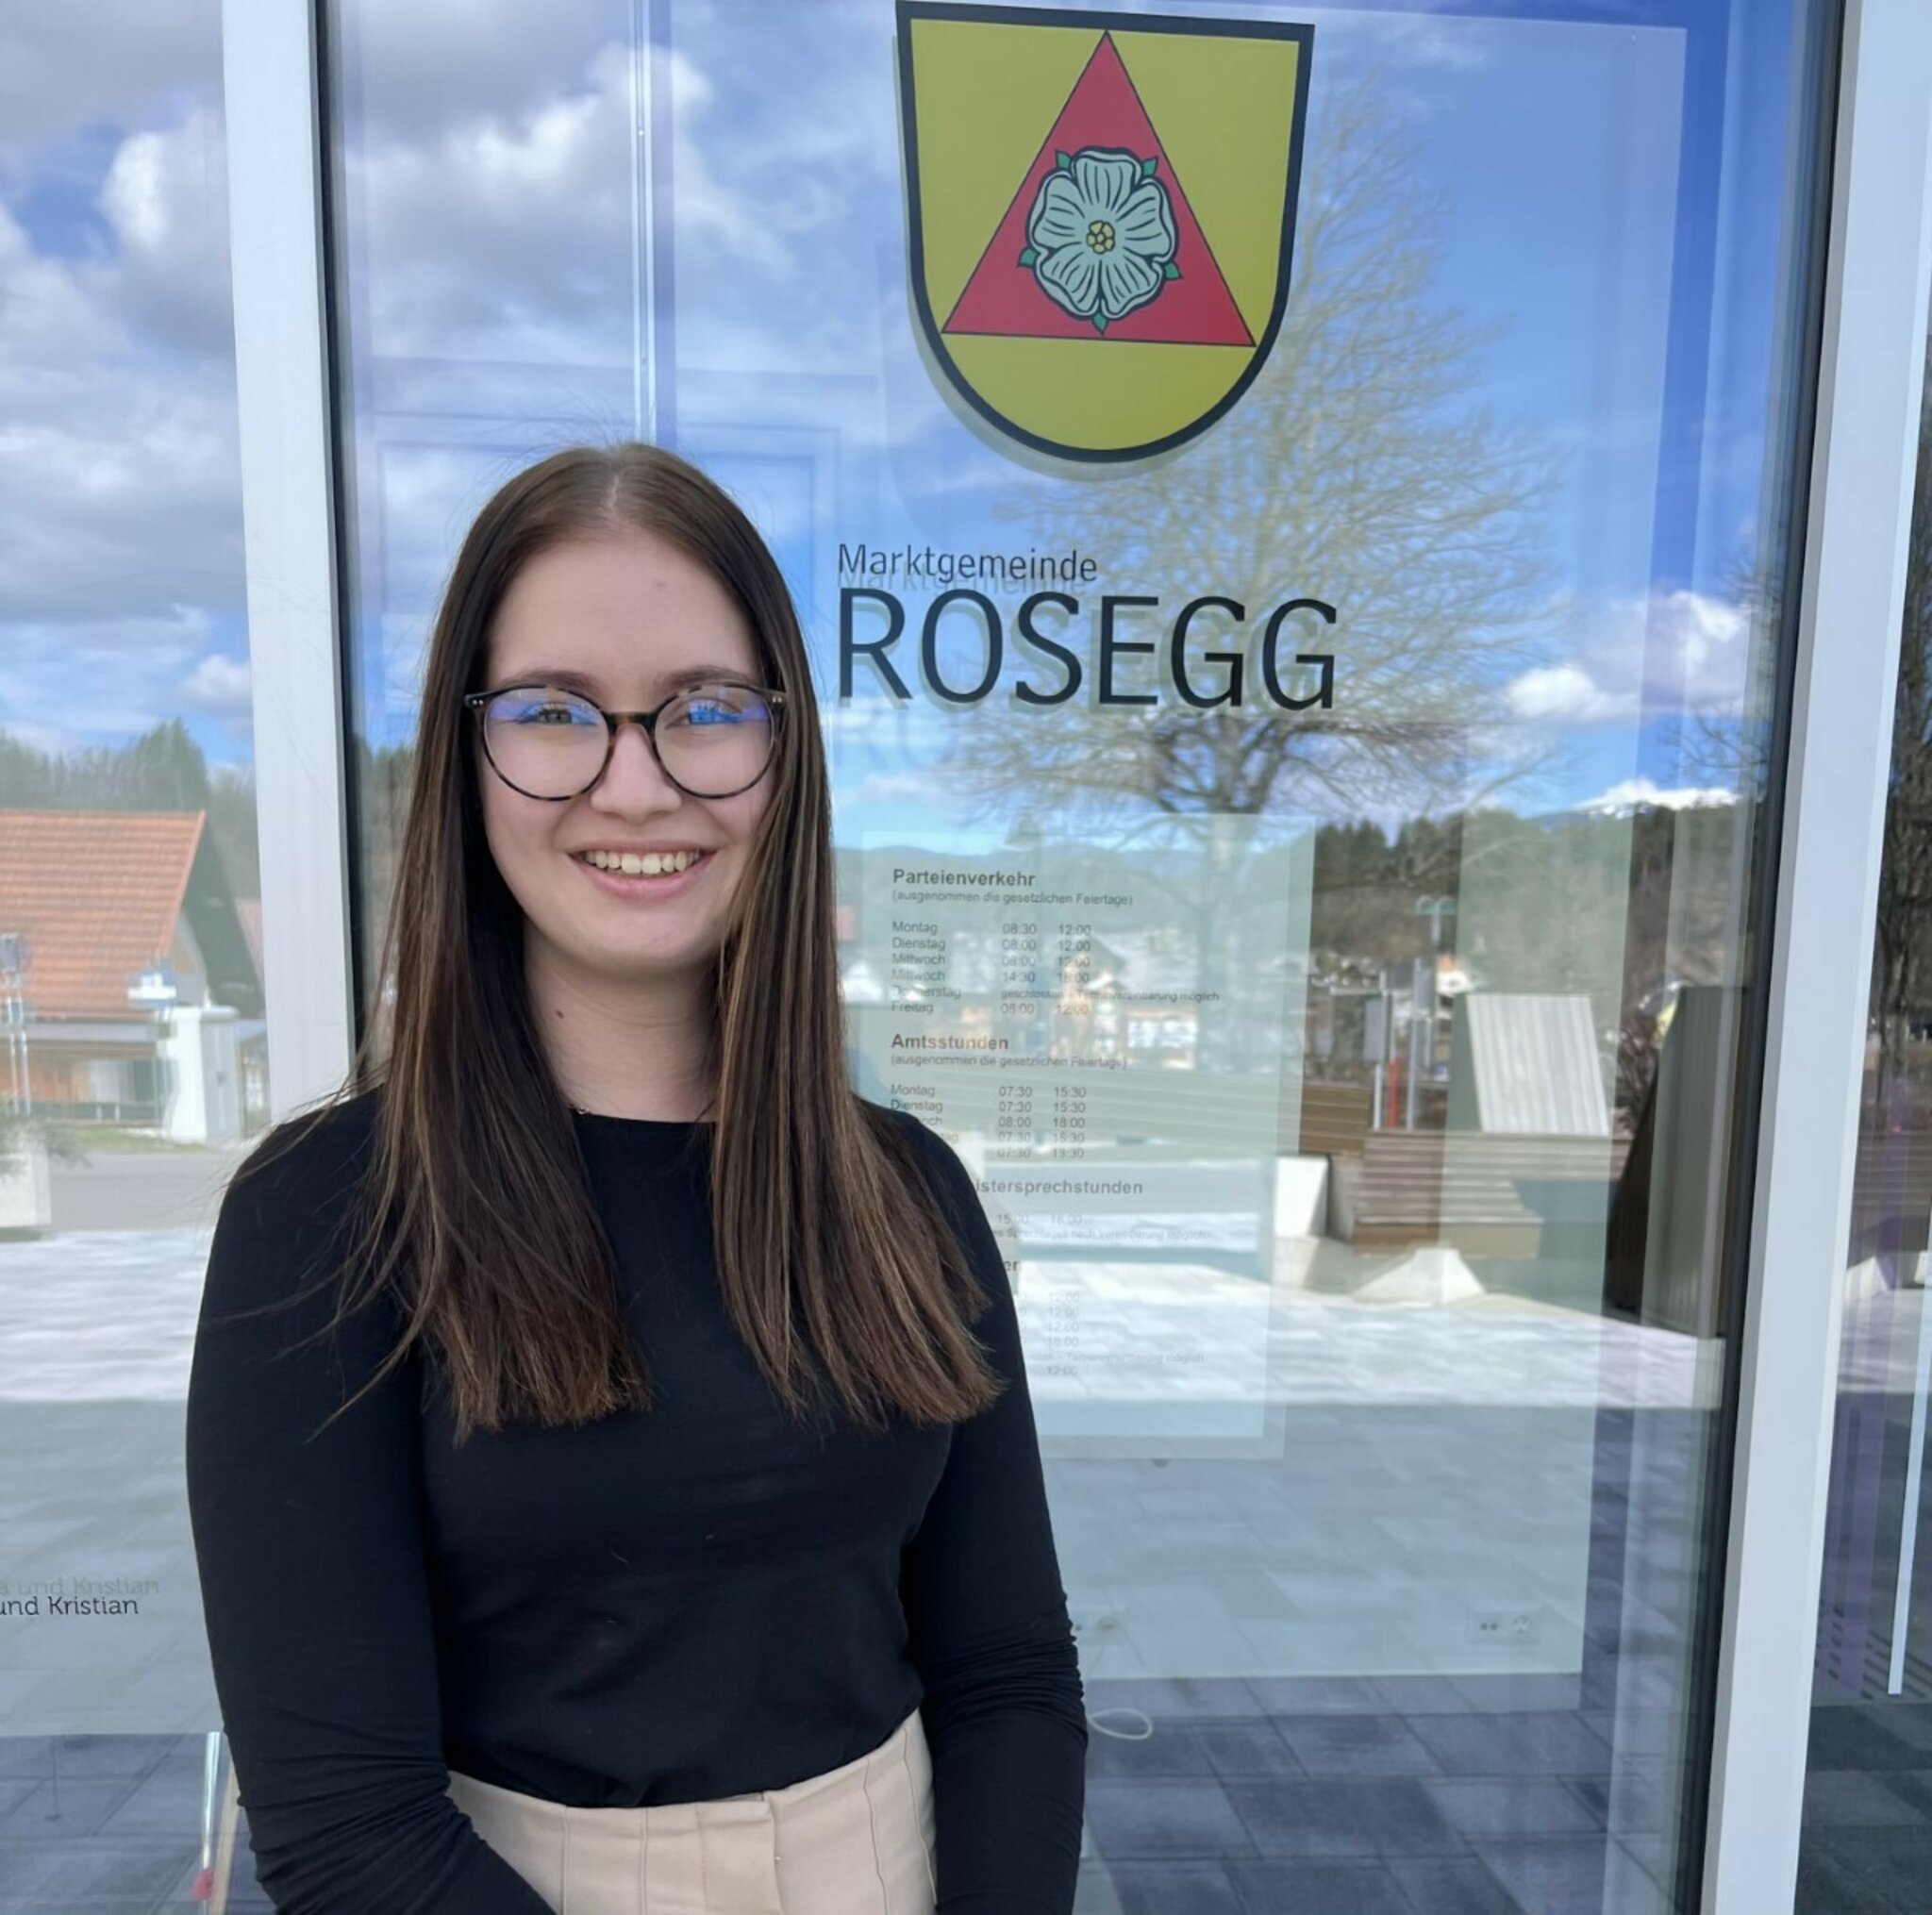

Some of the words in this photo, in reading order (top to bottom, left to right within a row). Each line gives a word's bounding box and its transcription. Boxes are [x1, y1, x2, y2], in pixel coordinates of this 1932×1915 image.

[839, 543, 1097, 583] Marktgemeinde
[839, 588, 1338, 710] ROSEGG
[892, 868, 1036, 887] Parteienverkehr
[892, 890, 980, 903] (ausgenommen
[983, 891, 1001, 902] die
[1003, 892, 1073, 906] gesetzlichen
[1076, 892, 1132, 907] Feiertage)
[892, 921, 938, 936] Montag
[1002, 923, 1037, 935] 08:30
[1058, 924, 1091, 936] 12:00
[892, 937, 945, 952] Dienstag
[1058, 940, 1091, 952] 12:00
[892, 953, 945, 965] Mittwoch
[892, 985, 961, 1000] Derstag
[891, 1001, 933, 1015] Freitag
[891, 1033, 1009, 1050] Amtsstunden
[891, 1055, 977, 1067] (ausgenommen
[979, 1055, 997, 1066] die
[891, 1083, 936, 1098] Montag
[998, 1086, 1033, 1097] 07:30
[1054, 1086, 1087, 1098] 15:30
[998, 1101, 1032, 1112] 07:30
[1054, 1101, 1086, 1113] 15:30
[998, 1116, 1032, 1127] 08:00
[1053, 1116, 1086, 1128] 18:00
[1053, 1132, 1085, 1143] 15:30
[975, 1178, 1143, 1196] istersprechstunden
[47, 1596, 139, 1615] Kristian
